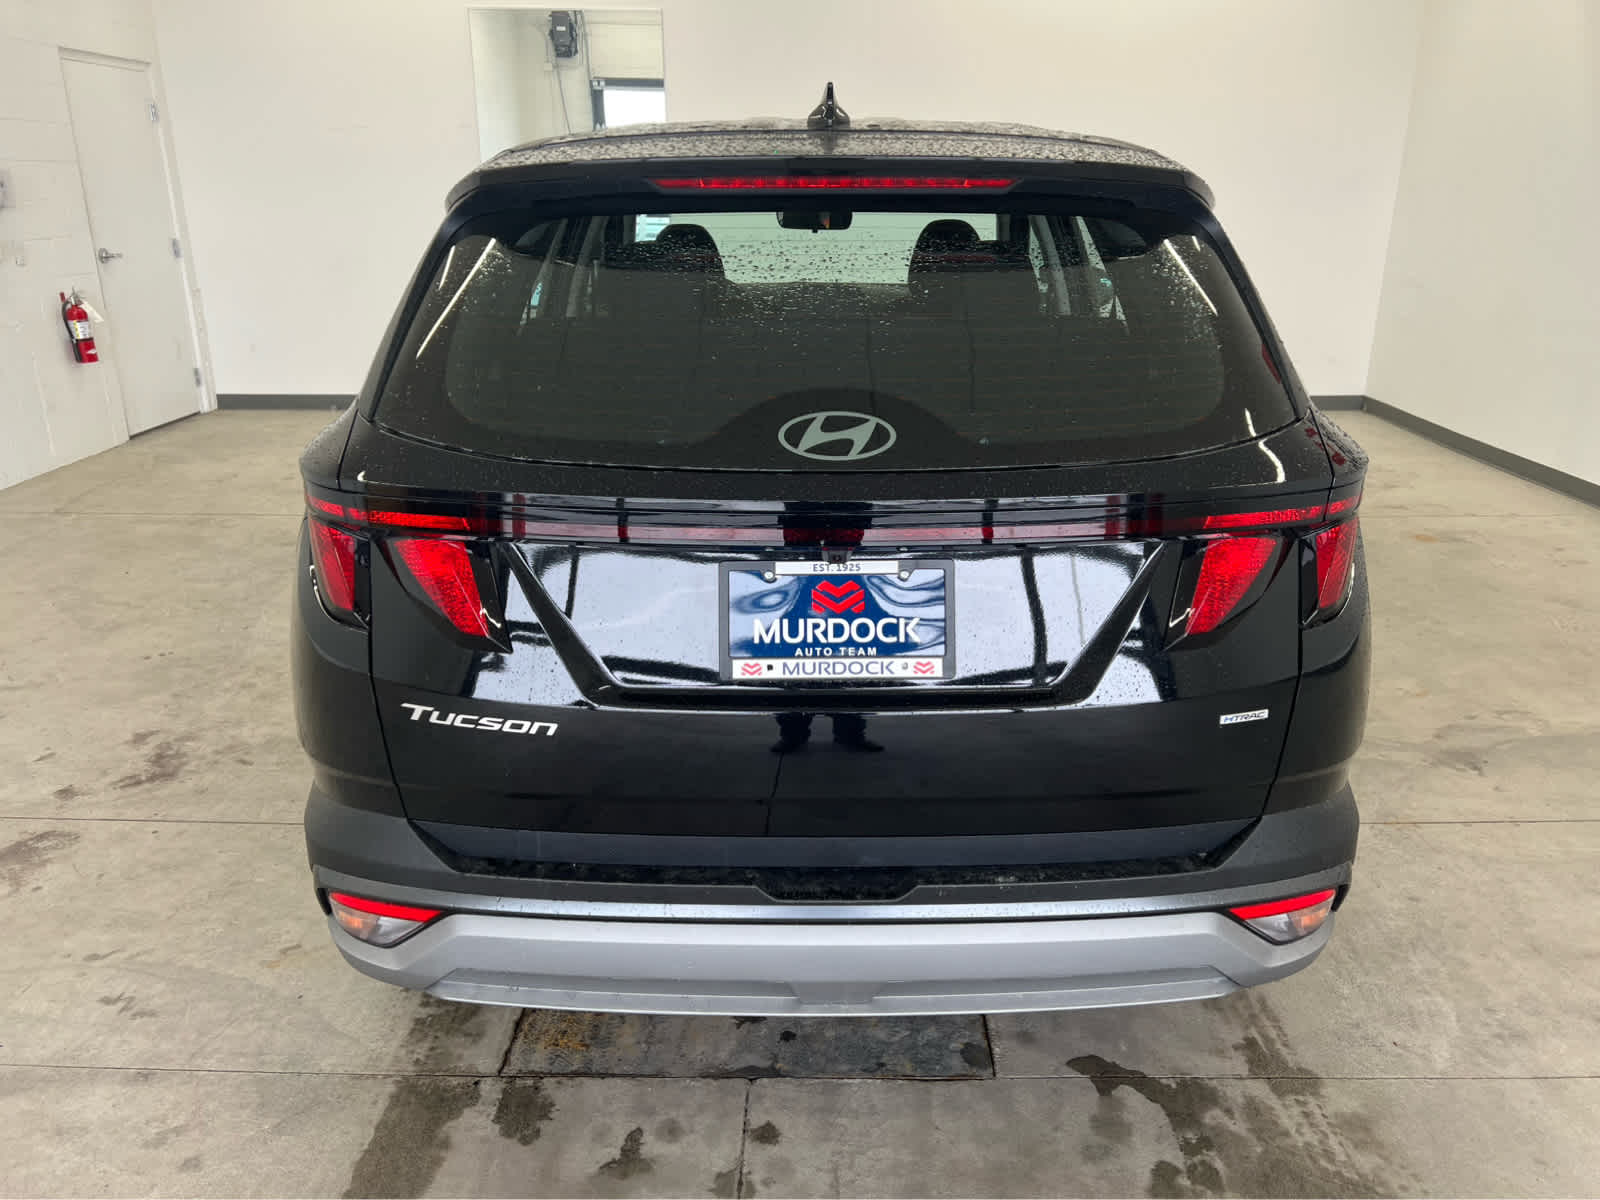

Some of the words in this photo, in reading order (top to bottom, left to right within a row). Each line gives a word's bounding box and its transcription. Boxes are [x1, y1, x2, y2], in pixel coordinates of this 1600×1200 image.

[812, 563, 835, 572] EST.
[837, 563, 861, 572] 1925
[753, 617, 920, 644] MURDOCK
[794, 647, 833, 657] AUTO
[838, 647, 877, 657] TEAM
[782, 661, 895, 675] MURDOCK
